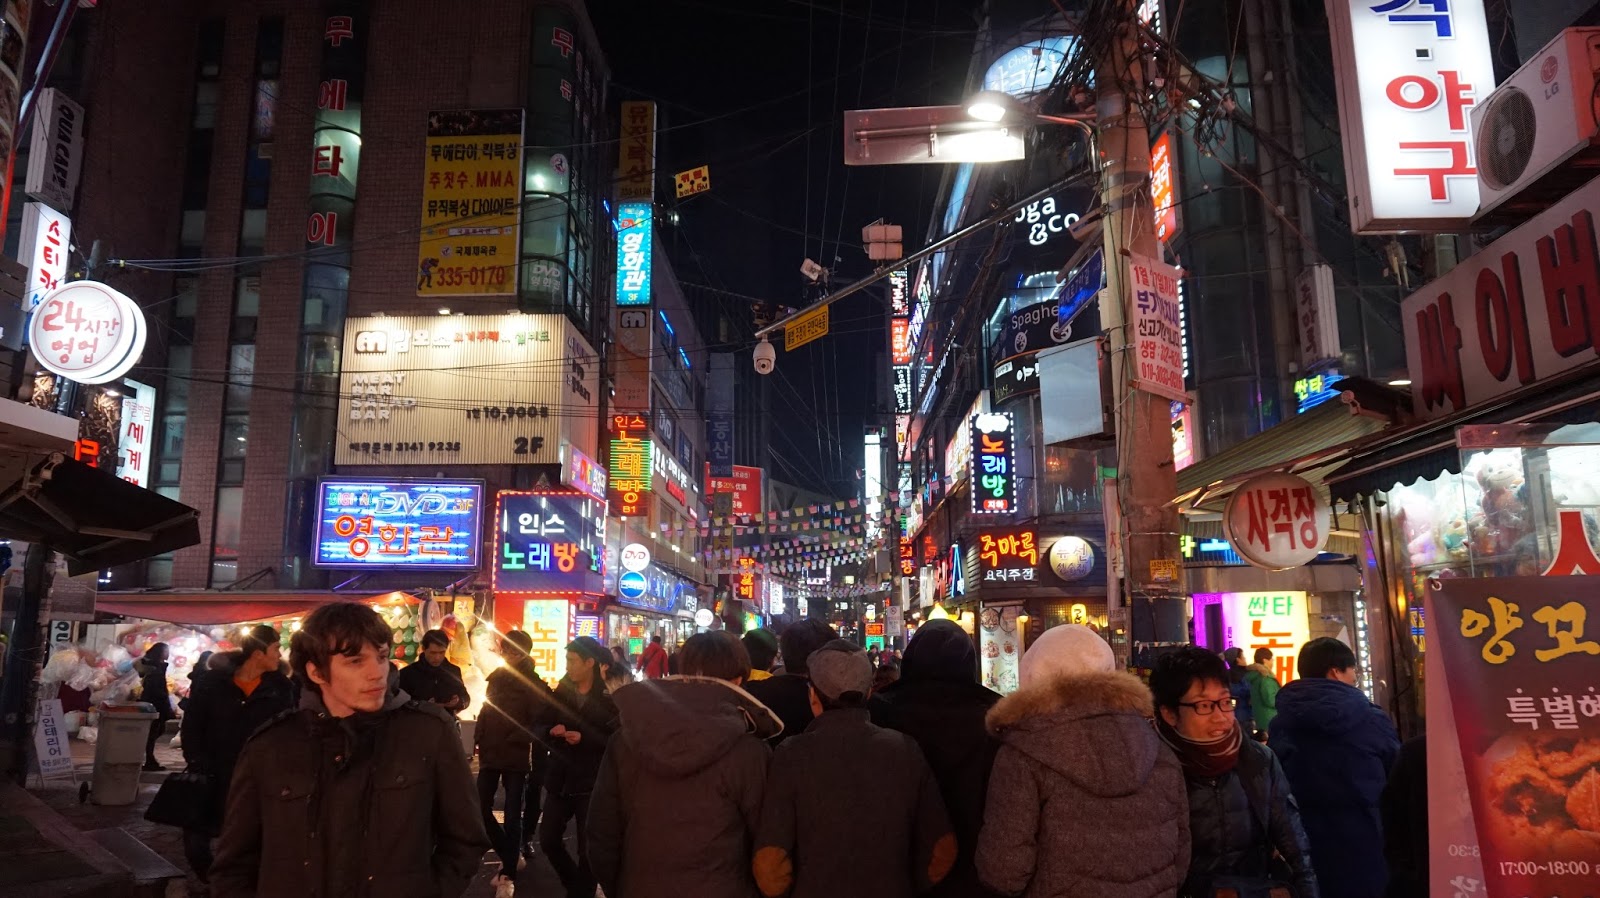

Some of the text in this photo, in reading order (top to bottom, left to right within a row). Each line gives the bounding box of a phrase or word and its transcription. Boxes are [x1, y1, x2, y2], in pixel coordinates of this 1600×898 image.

[1544, 83, 1560, 99] LG
[305, 16, 353, 245] 무에타이
[53, 104, 75, 189] QUACAFE
[476, 170, 514, 188] MMA
[620, 232, 647, 291] 영화관
[436, 266, 506, 287] 335-0170
[627, 292, 639, 301] 3F
[42, 301, 120, 337] 24시간
[1011, 304, 1060, 330] Spaghe
[51, 337, 99, 364] 영업
[351, 373, 406, 386] MEAT
[351, 385, 393, 397] BAR
[350, 409, 391, 421] BAR
[614, 415, 646, 427] 인스
[514, 437, 544, 454] 2F
[617, 431, 645, 504] 노래방
[981, 434, 1007, 498] 노래방
[375, 492, 448, 516] DVD
[453, 498, 474, 513] 3F
[622, 505, 636, 513] B1
[518, 512, 565, 535] 인스
[1248, 486, 1319, 553] 사격장
[334, 515, 454, 559] 영화관
[502, 542, 579, 573] 노래방
[624, 549, 646, 560] DVD
[984, 567, 1034, 582] 요리주점
[1248, 596, 1294, 617] 싼타
[42, 716, 62, 757] 인테리어
[1499, 860, 1590, 876] 17:00~18:00
